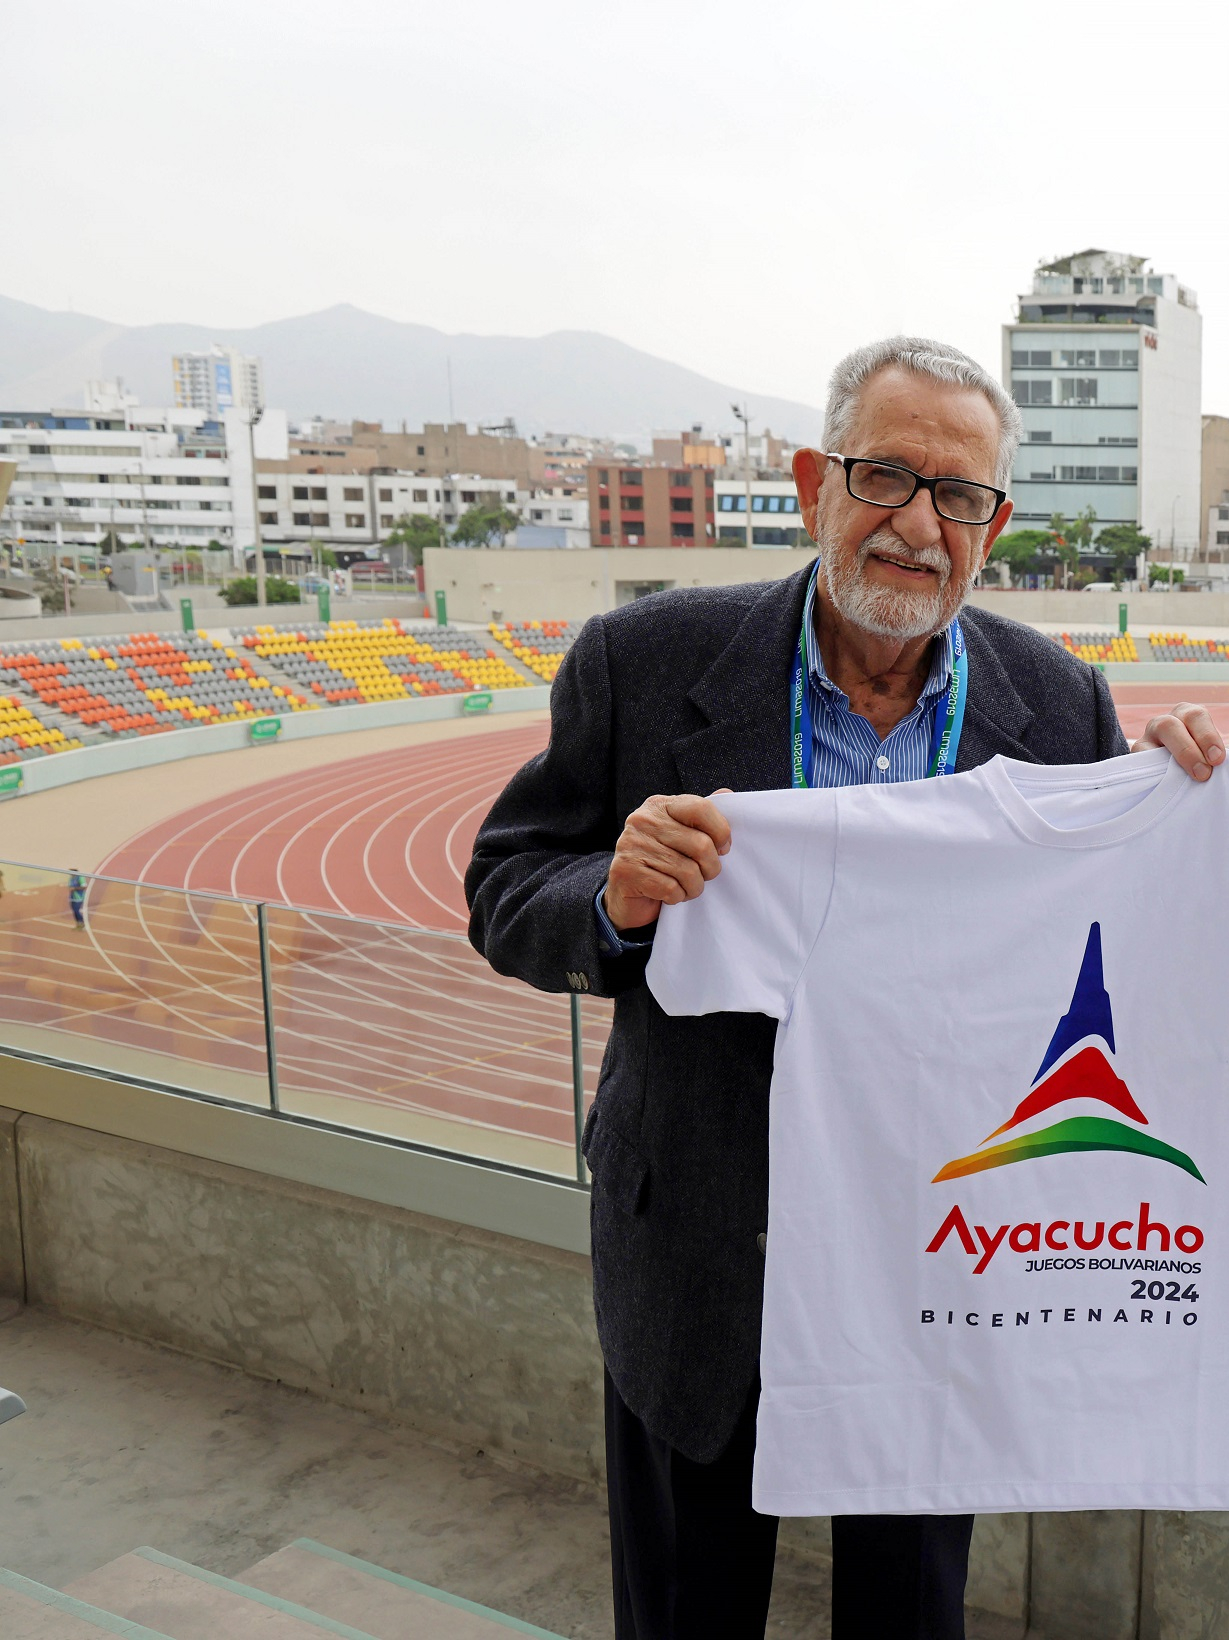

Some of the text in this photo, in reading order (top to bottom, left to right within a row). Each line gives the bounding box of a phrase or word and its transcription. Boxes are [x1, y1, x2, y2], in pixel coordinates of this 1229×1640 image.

[925, 1202, 1205, 1275] Ayacucho
[1024, 1257, 1202, 1275] JUEGOS BOLIVARIANOS
[1130, 1279, 1200, 1303] 2024
[920, 1308, 1198, 1328] BICENTENARIO
